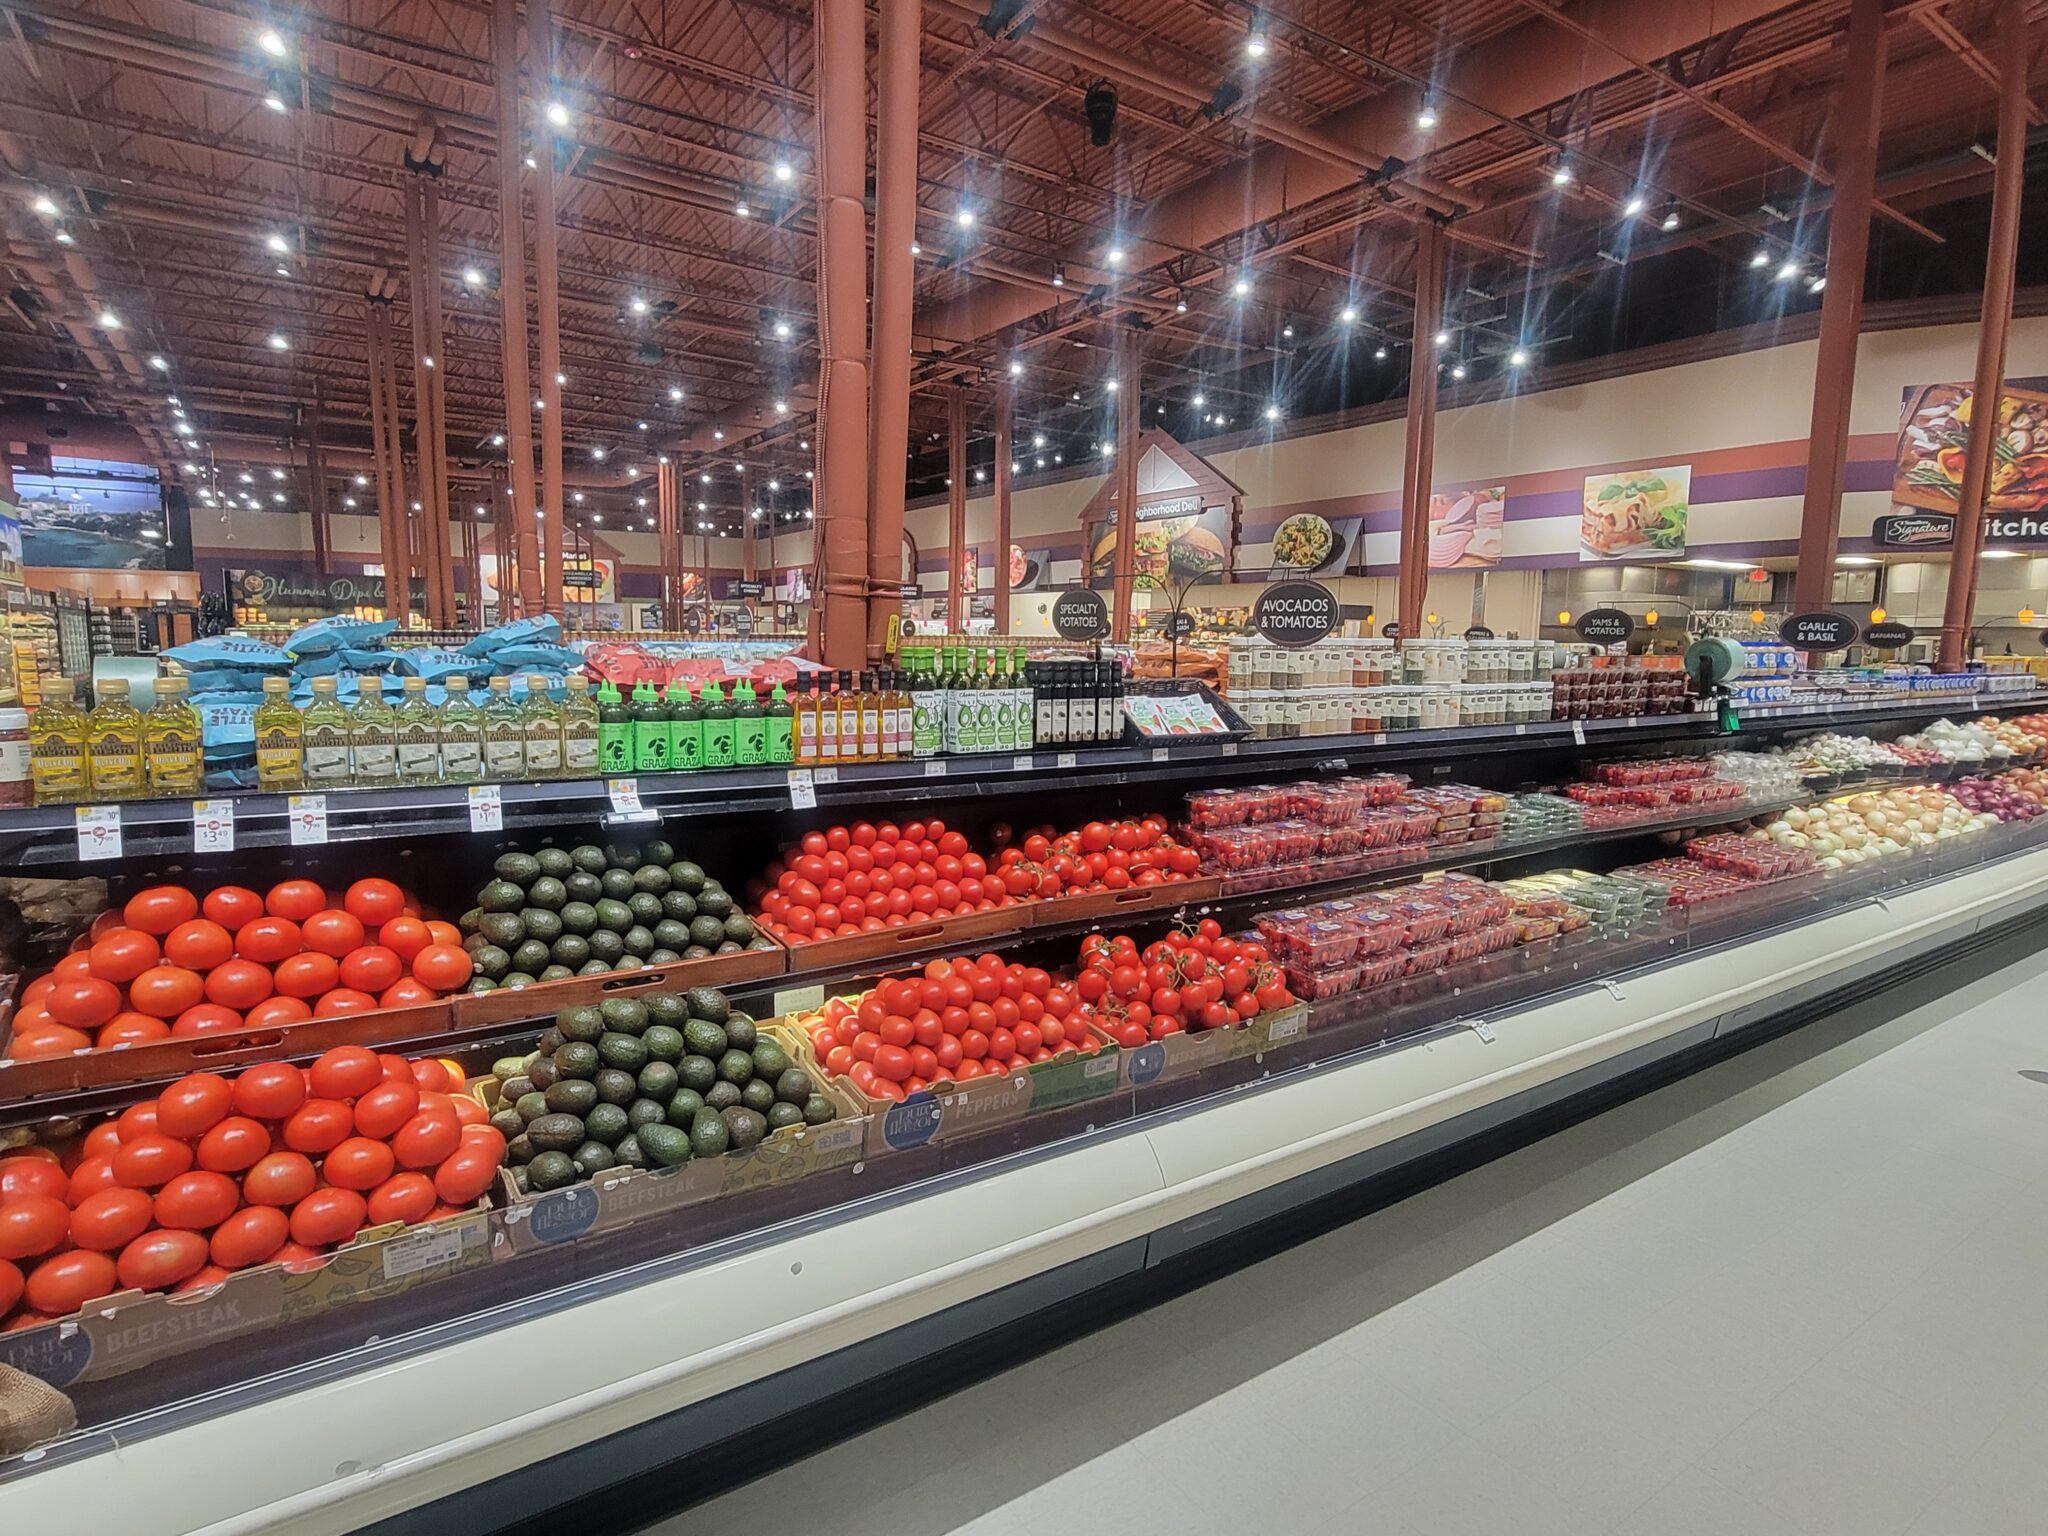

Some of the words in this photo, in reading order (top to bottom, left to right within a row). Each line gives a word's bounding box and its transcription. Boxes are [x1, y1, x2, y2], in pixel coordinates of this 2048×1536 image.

[1135, 503, 1180, 522] ighborhood
[1182, 500, 1198, 512] Deli
[1888, 520, 1950, 542] Signature
[1985, 517, 2048, 537] itche
[562, 552, 587, 560] Maret
[374, 581, 385, 598] &
[1059, 603, 1098, 614] SPECIALTY
[1261, 599, 1329, 613] AVOCADOS
[1059, 616, 1098, 627] POTATOES
[1261, 617, 1267, 629] &
[1269, 616, 1328, 629] TOMATOES
[1591, 618, 1611, 627] YAMS
[1613, 618, 1620, 627] &
[1798, 621, 1839, 632] GARLIC
[1584, 627, 1625, 637] POTATOES
[1797, 632, 1804, 641] &
[1807, 632, 1836, 642] BASIL
[1870, 631, 1906, 640] BANANAS
[211, 716, 253, 727] ITTLE
[742, 752, 767, 763] GRAZ
[601, 760, 630, 771] GRAZA
[956, 1091, 1019, 1119] PEPPERS
[608, 1176, 696, 1212] BEEFSTEAK
[106, 1299, 241, 1350] BEEFSTEAK
